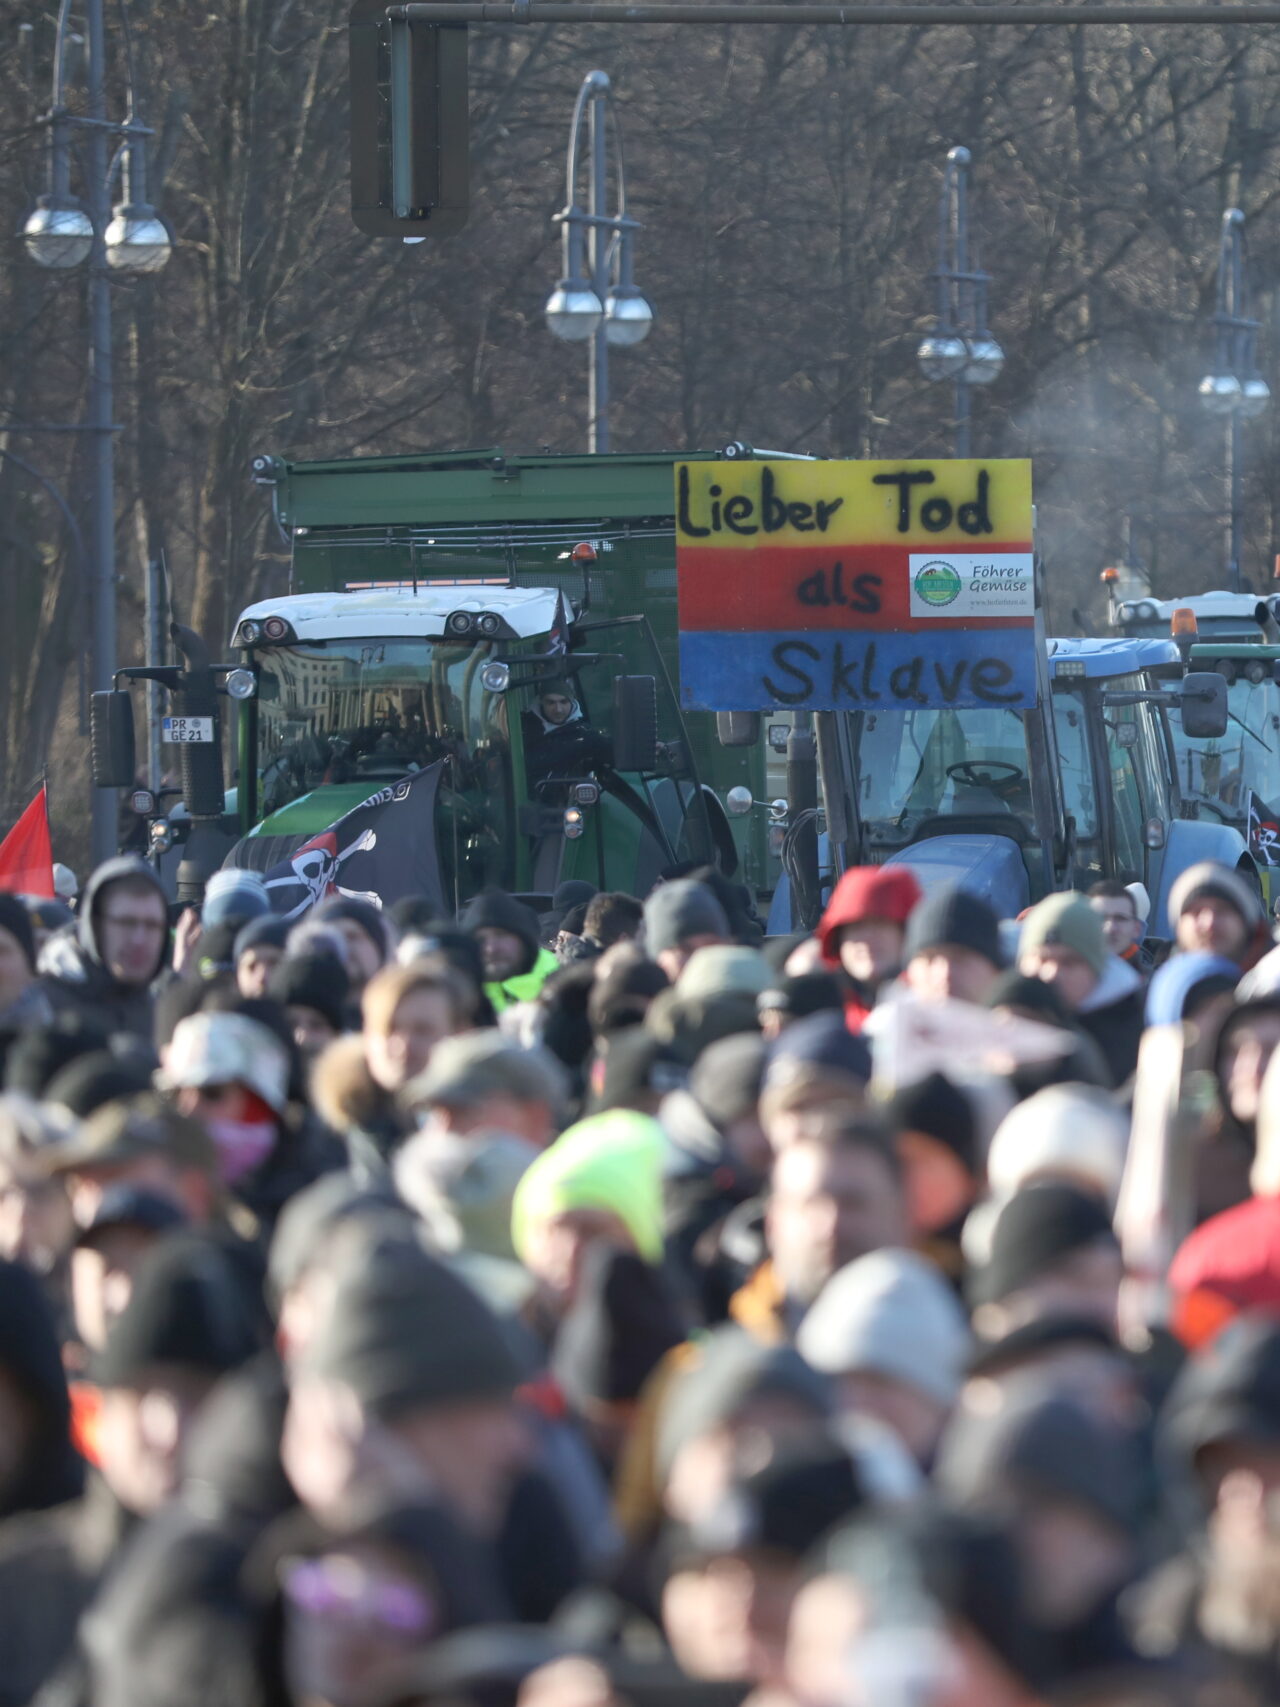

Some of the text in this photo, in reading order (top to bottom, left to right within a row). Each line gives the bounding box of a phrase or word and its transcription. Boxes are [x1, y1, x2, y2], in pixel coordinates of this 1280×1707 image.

[679, 465, 993, 537] Lieber Tod
[973, 565, 1023, 578] Föhrer
[797, 562, 883, 613] als
[969, 580, 1027, 592] Gemüse
[762, 641, 1025, 704] Sklave
[171, 719, 187, 730] PR
[171, 730, 203, 741] GE 21
